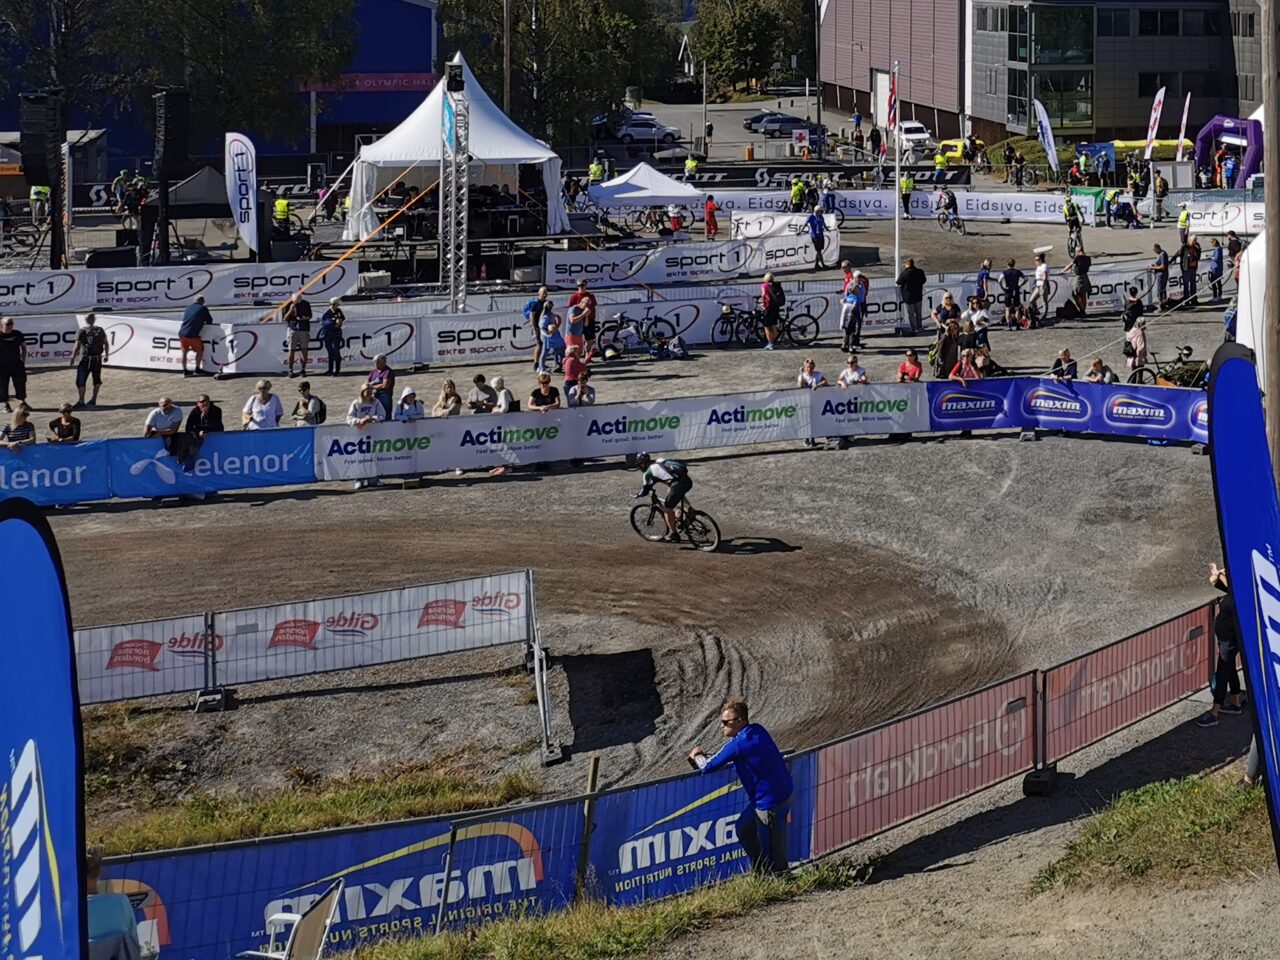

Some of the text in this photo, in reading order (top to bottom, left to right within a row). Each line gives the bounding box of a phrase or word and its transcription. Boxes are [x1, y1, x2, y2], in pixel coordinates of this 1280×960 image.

[1034, 200, 1093, 215] Eidsa.
[665, 251, 726, 269] sport
[765, 244, 810, 261] sport
[555, 261, 618, 278] sport
[96, 277, 176, 296] sport
[233, 273, 309, 290] sport
[1089, 280, 1133, 297] port
[437, 324, 522, 344] sport
[821, 397, 909, 416] Actimove
[942, 400, 996, 410] maxim
[1031, 399, 1080, 410] maxim
[1113, 406, 1164, 417] maxim
[707, 405, 796, 425] Actimove
[587, 416, 680, 436] Actimove
[460, 426, 559, 447] Actimove
[327, 435, 431, 457] Actimove
[184, 451, 295, 477] elenor
[0, 465, 87, 490] lenor
